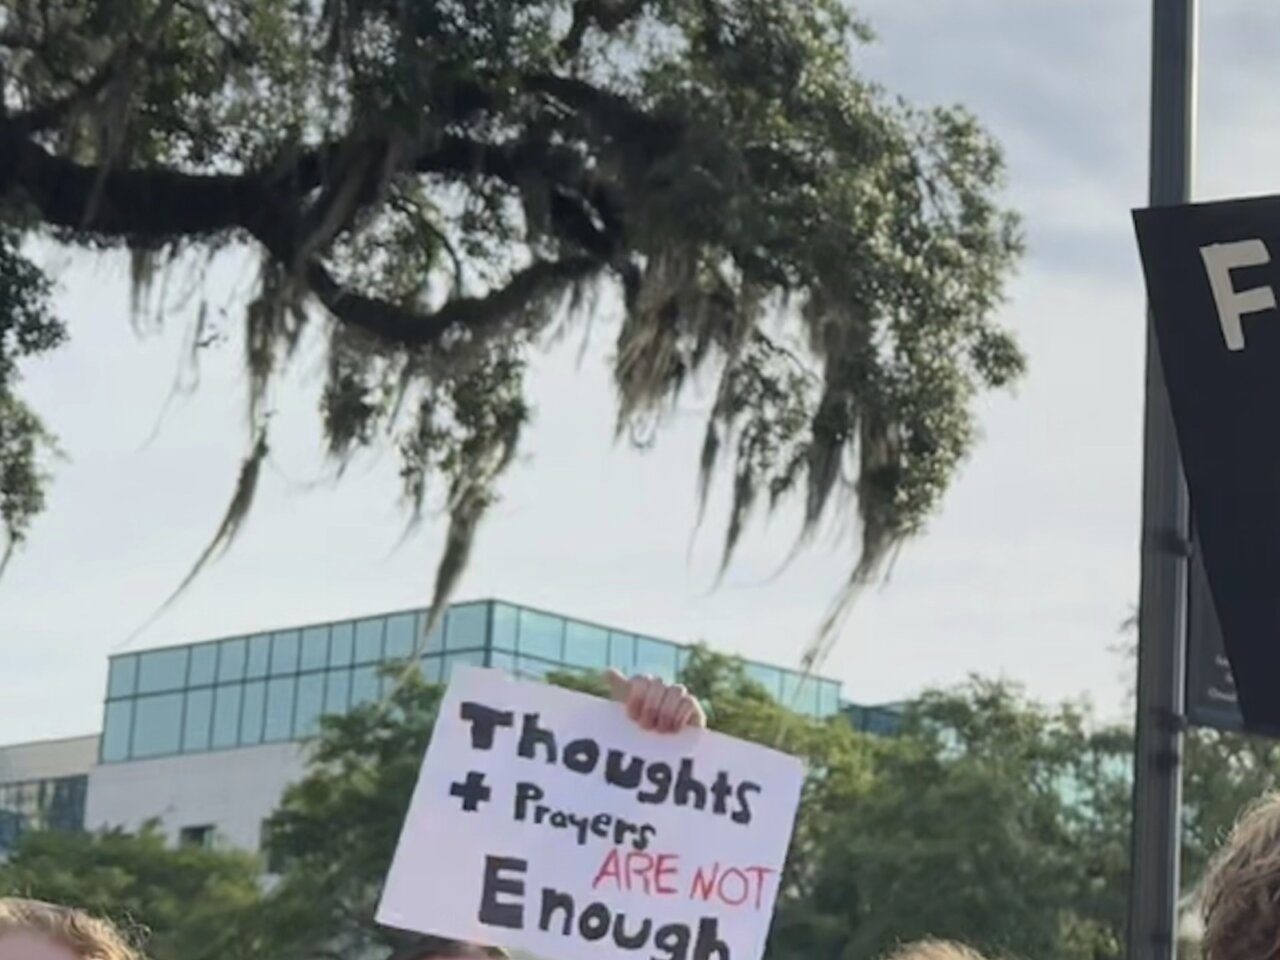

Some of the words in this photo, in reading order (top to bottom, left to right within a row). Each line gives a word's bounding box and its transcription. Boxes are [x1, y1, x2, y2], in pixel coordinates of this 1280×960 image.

[459, 701, 761, 826] Thoughts
[513, 781, 657, 851] Prayers
[592, 848, 679, 895] ARE
[689, 861, 778, 910] NOT
